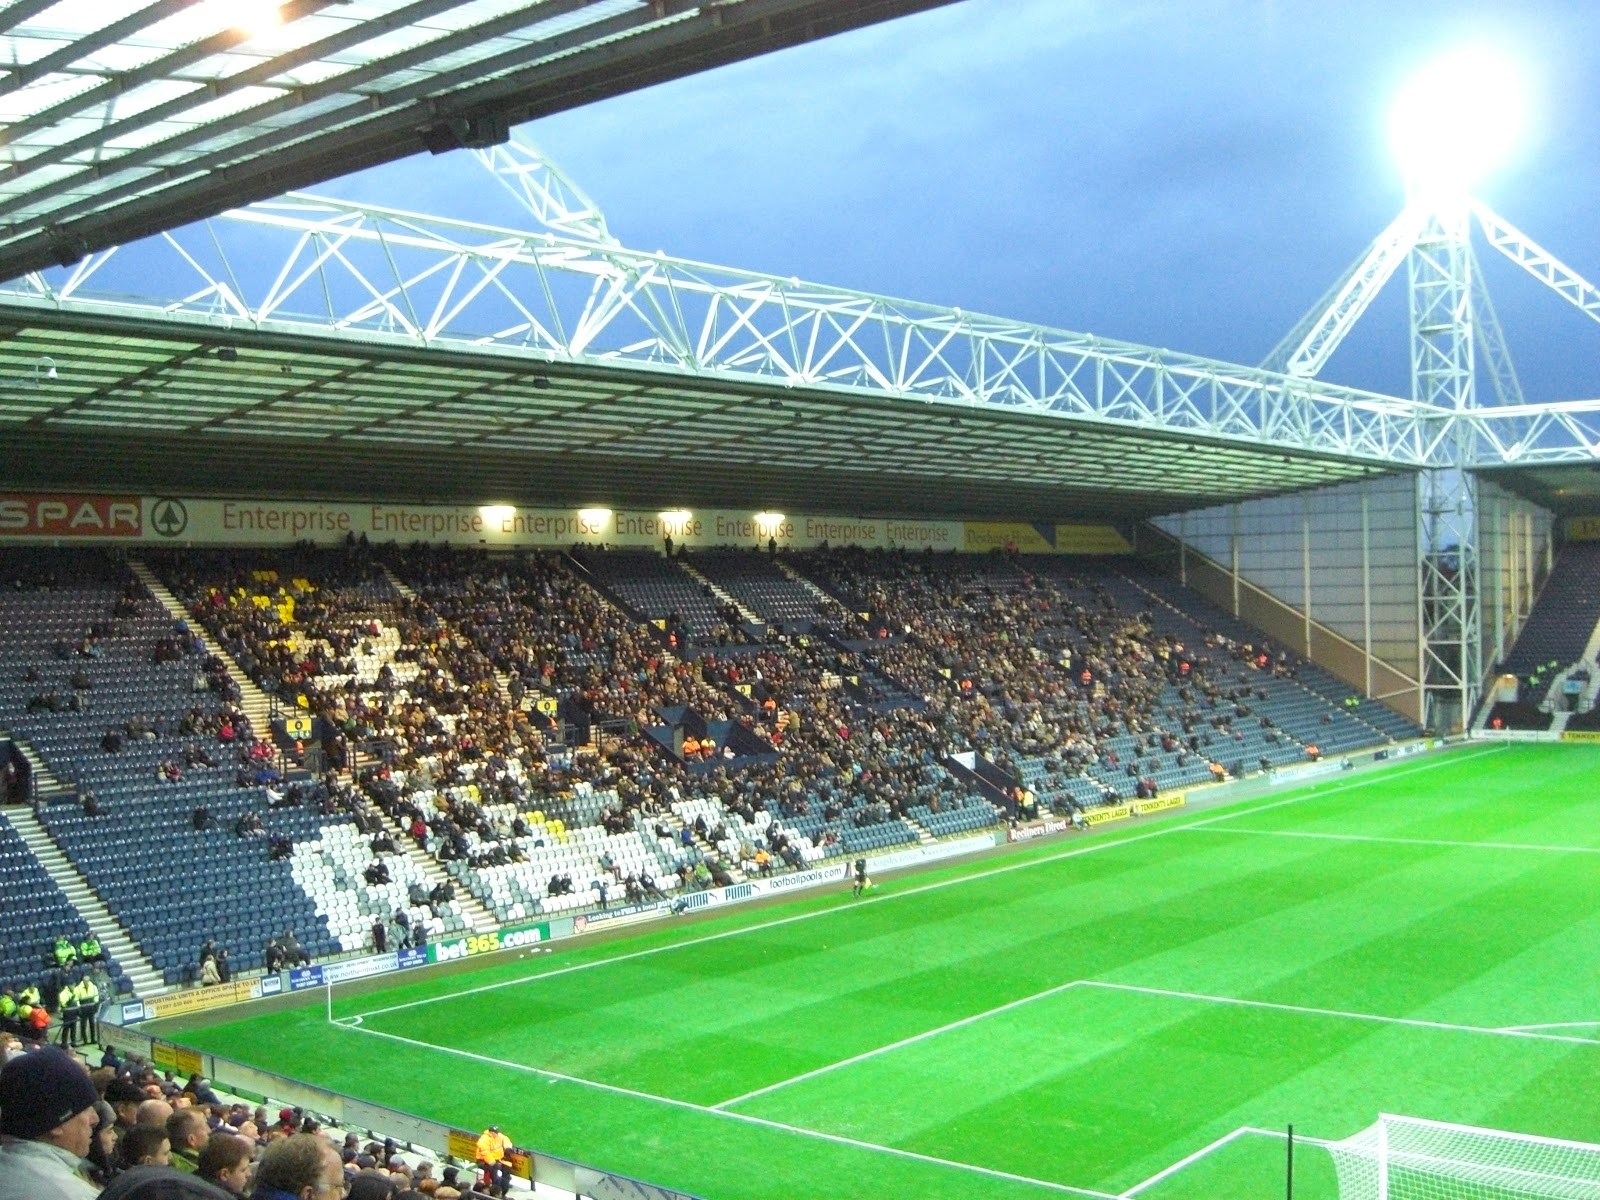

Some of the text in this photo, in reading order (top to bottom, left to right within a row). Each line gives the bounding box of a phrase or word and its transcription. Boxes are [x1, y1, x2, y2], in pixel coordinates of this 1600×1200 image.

[0, 501, 140, 529] SPAR
[223, 502, 949, 544] Enterprise Enterprise Enterprise Enterprise Enterprise Enterprise Enterprise
[1111, 808, 1129, 818] LAGER
[1010, 819, 1067, 841] Recliners Direct
[769, 866, 842, 890] footballpools.com
[725, 884, 752, 901] PUMA
[588, 911, 613, 922] Looking
[642, 902, 657, 912] local
[435, 927, 541, 961] bet365.com
[145, 995, 177, 1006] INDUSTRIAL
[178, 991, 195, 999] UNITS
[201, 986, 221, 995] OFFICE
[222, 983, 241, 991] SPACE
